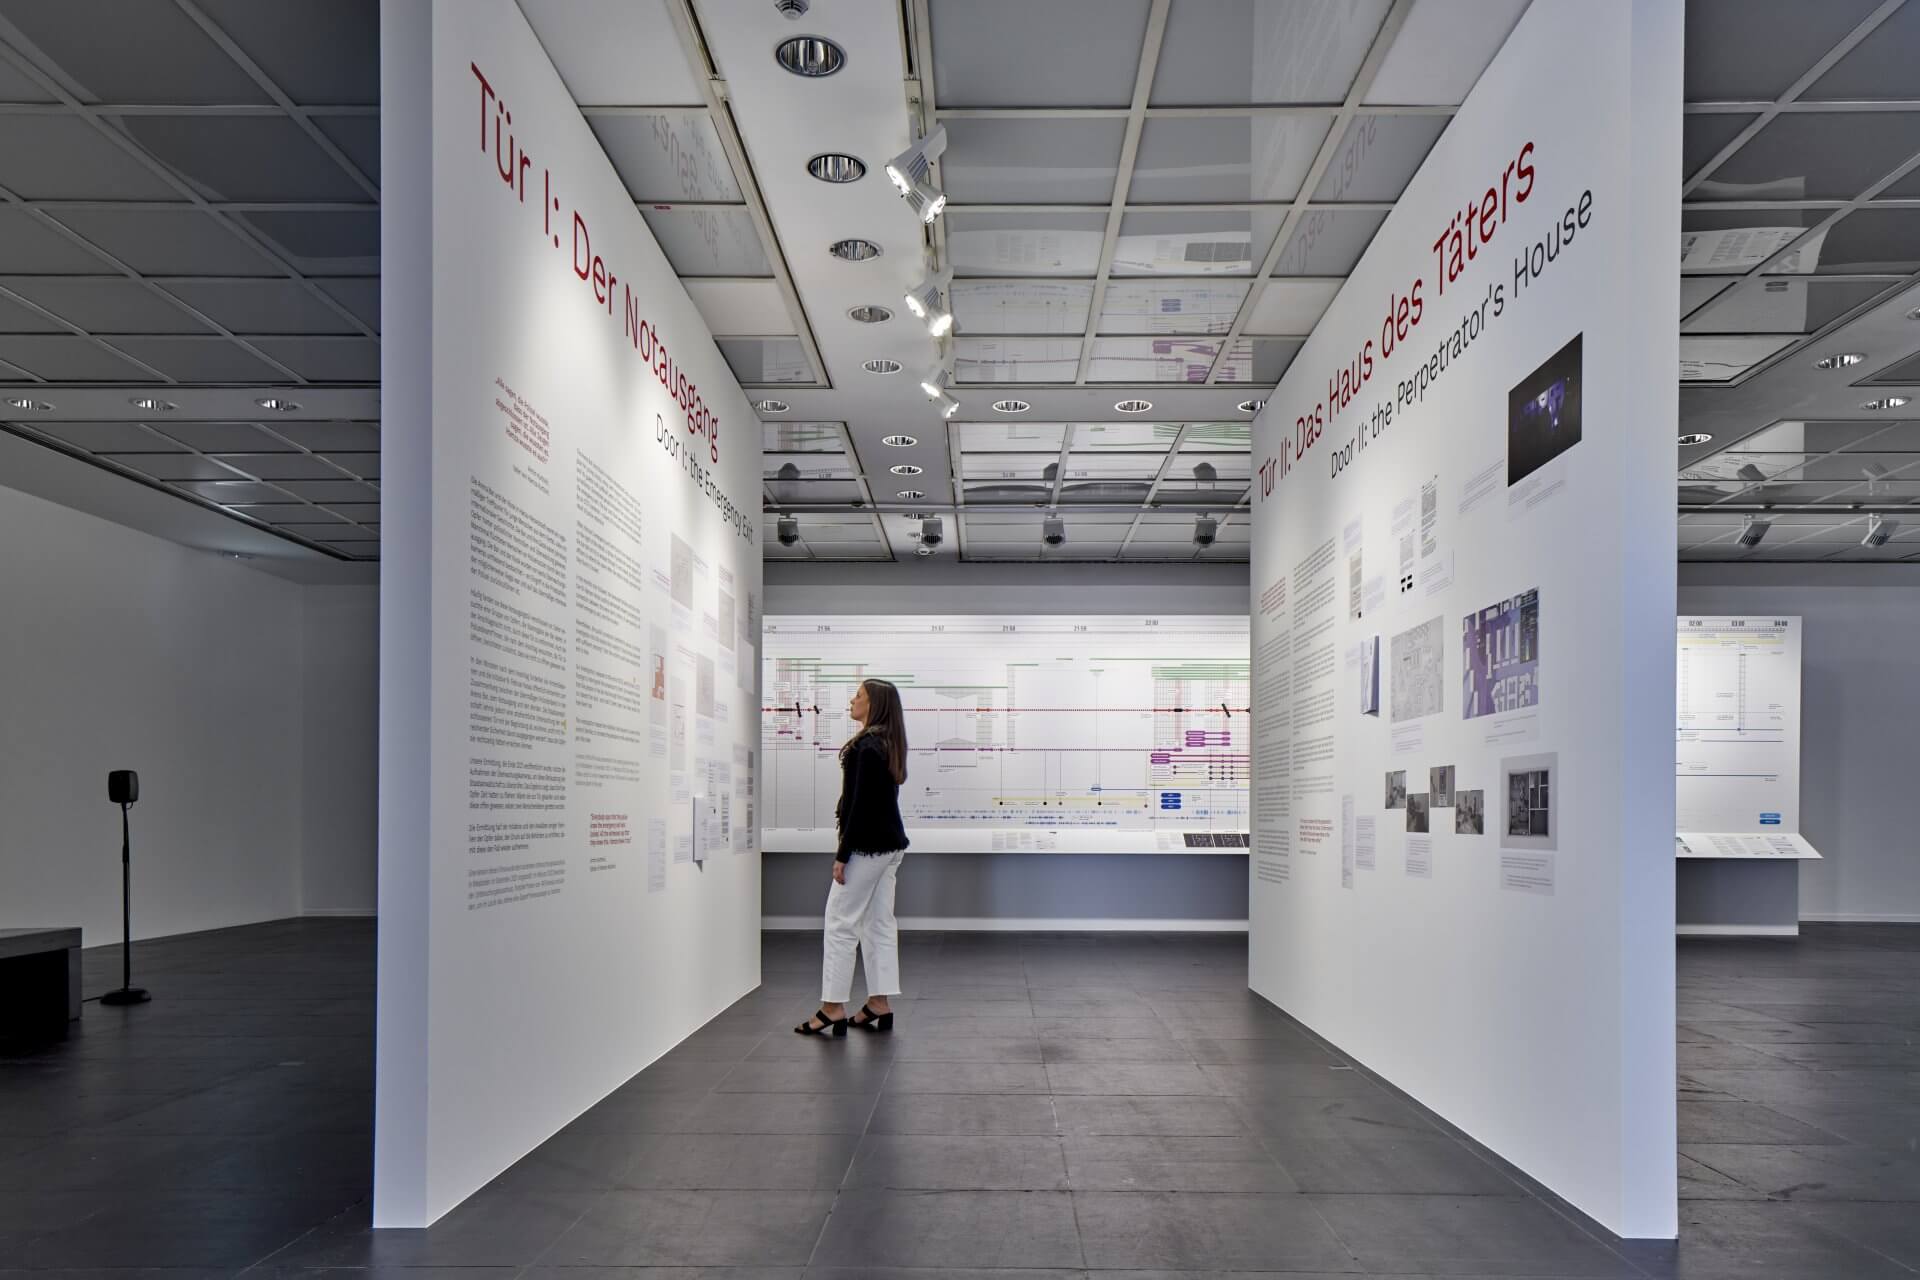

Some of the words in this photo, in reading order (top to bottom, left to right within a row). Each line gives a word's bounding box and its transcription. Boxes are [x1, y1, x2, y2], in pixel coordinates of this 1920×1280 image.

[471, 62, 531, 203] Tür
[545, 169, 560, 248] I:
[573, 210, 617, 315] Der
[625, 283, 719, 463] Notausgang
[1258, 452, 1279, 502] Tür
[1280, 437, 1292, 480] II:
[1296, 405, 1323, 461] Das
[1329, 339, 1373, 424] Haus
[1381, 278, 1423, 359] des
[1432, 141, 1535, 296] Täters
[1331, 440, 1354, 480] Door
[1357, 421, 1368, 452] II:
[1371, 399, 1393, 440] the
[1397, 283, 1504, 416] Perpetrator's
[1514, 188, 1593, 299] House
[656, 412, 679, 461] Door
[682, 441, 688, 471] I:
[689, 451, 703, 488] the
[705, 469, 742, 537] Emergency
[743, 514, 754, 545] Exit
